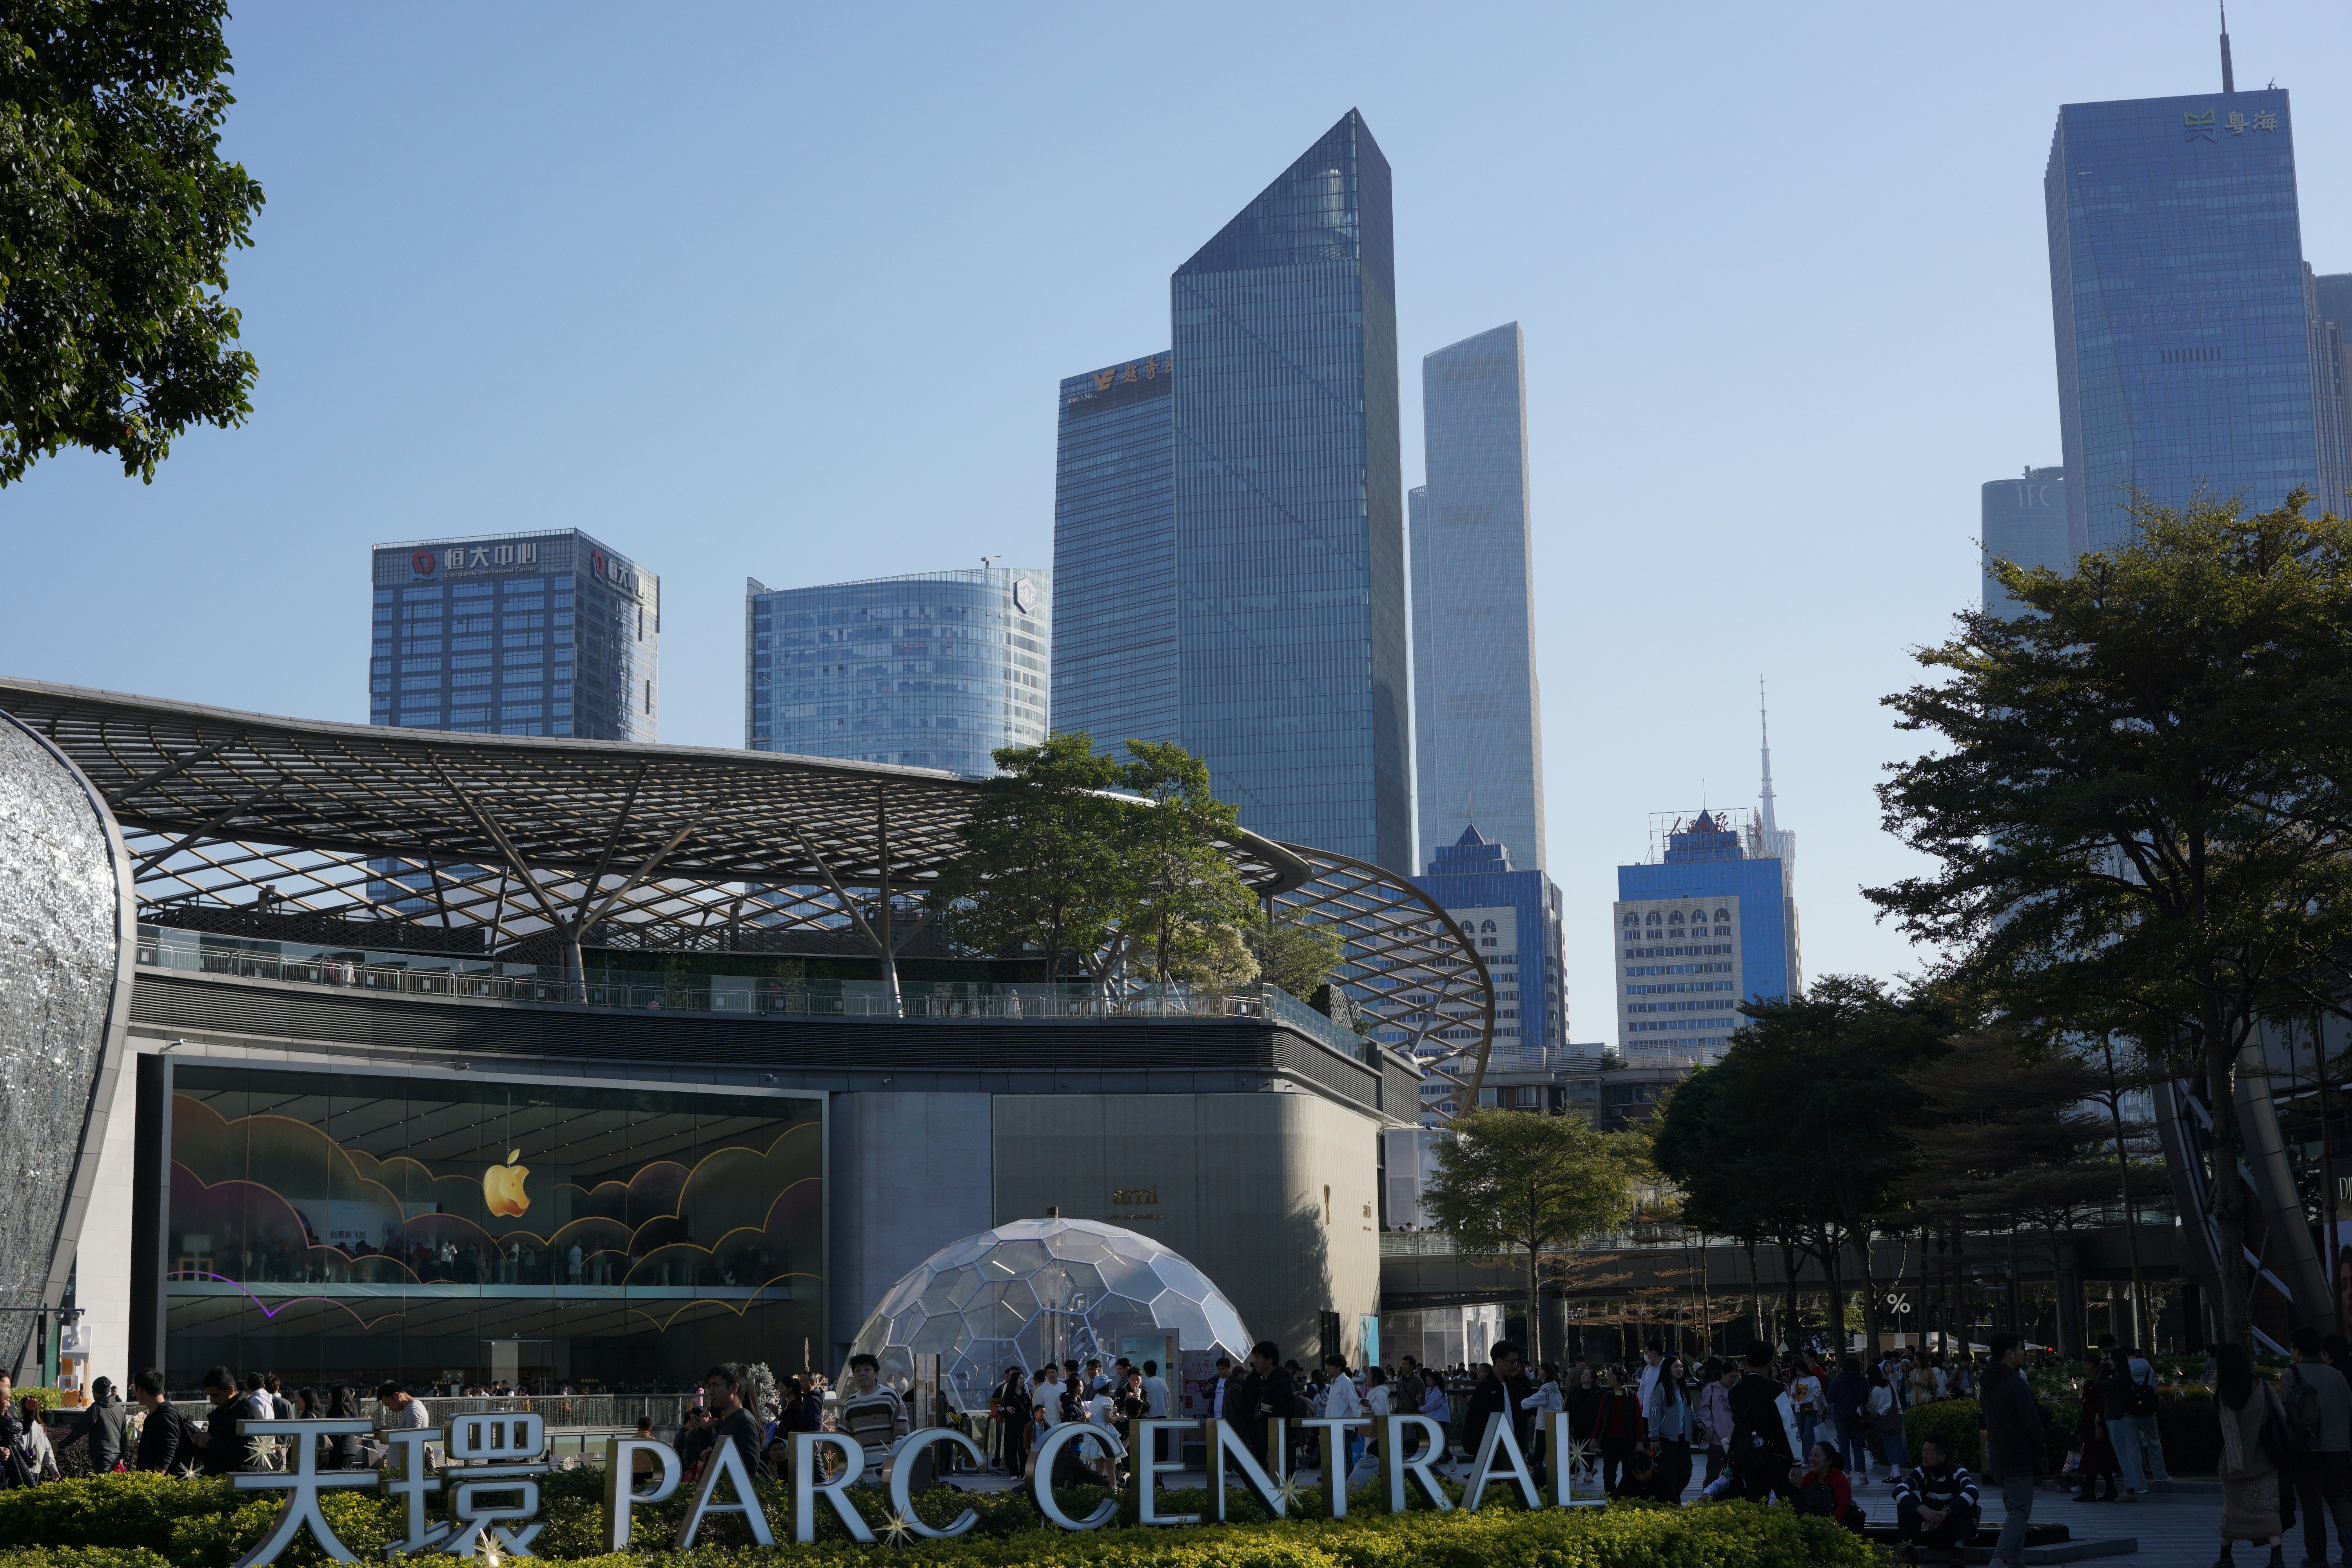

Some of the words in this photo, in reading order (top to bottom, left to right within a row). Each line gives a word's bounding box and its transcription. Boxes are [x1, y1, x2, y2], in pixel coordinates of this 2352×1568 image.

[2225, 110, 2278, 134] 粤海
[2018, 484, 2049, 507] IFC
[445, 543, 537, 570] 恒大中心
[608, 558, 646, 598] 恒大中心
[1018, 588, 1035, 604] R&F
[1113, 1184, 1159, 1205] ami
[330, 1231, 366, 1239] 创意新飞跃
[603, 1427, 985, 1553] PARC
[1025, 1412, 1608, 1530] CENTRAL
